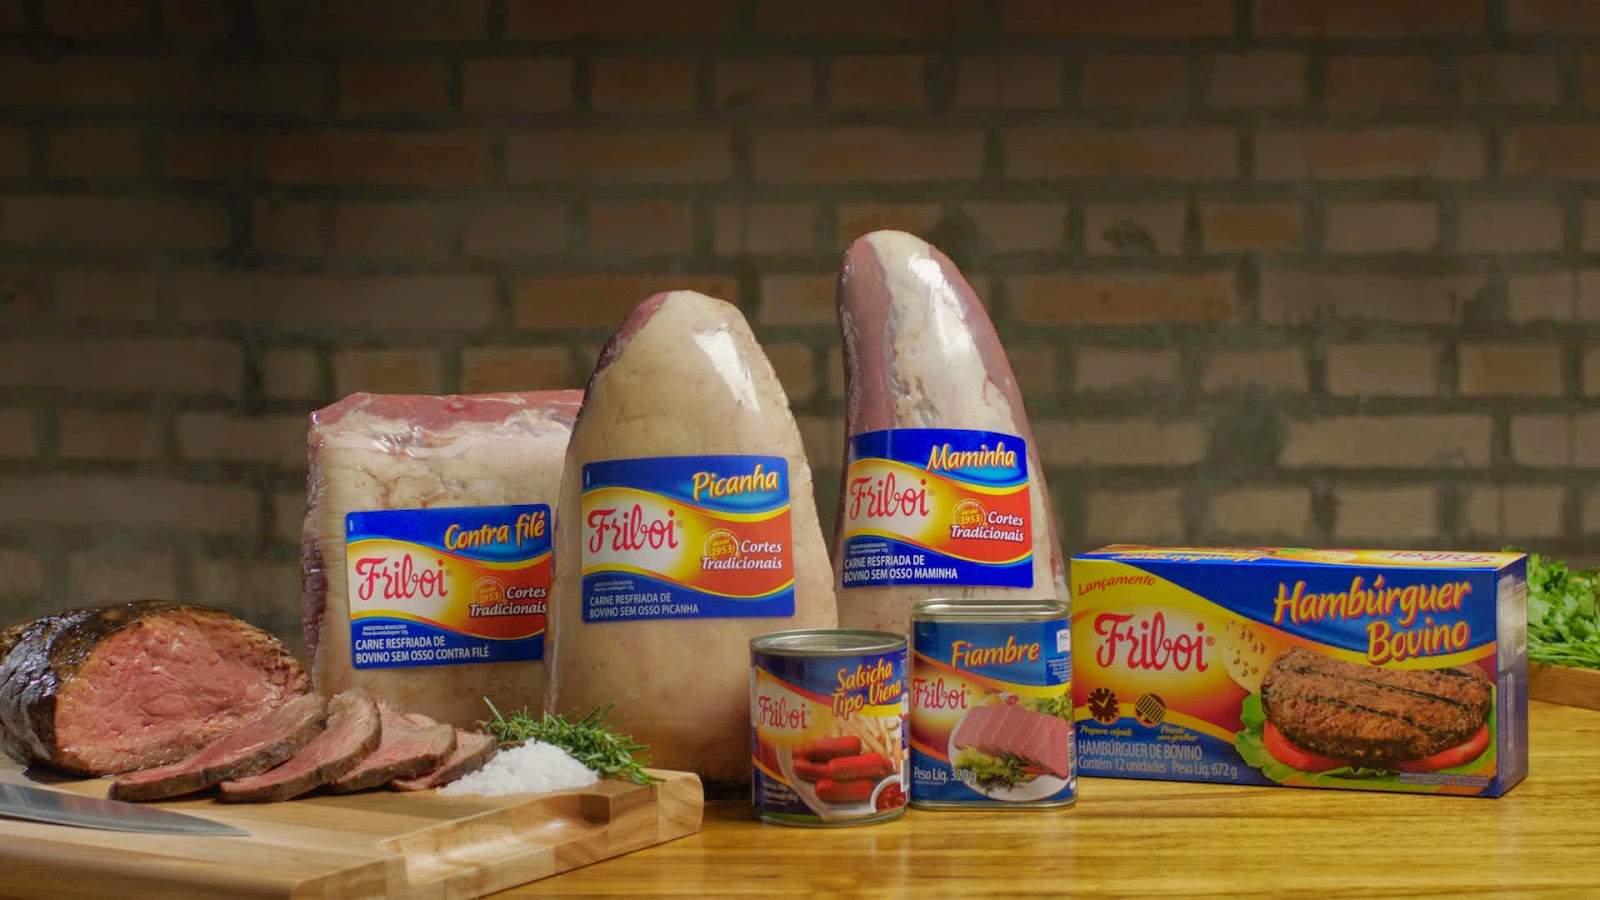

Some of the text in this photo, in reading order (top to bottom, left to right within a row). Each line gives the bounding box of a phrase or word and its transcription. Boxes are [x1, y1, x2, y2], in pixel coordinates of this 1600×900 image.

[926, 442, 1016, 472] Maminha
[692, 464, 779, 500] Picanha
[850, 472, 929, 520] Friboi
[961, 514, 981, 525] 1953
[988, 511, 1023, 526] Cortes
[444, 511, 547, 550] Contra filé
[951, 525, 1024, 542] Tradicionais
[712, 545, 733, 556] 1953
[741, 540, 782, 553] Cortes
[702, 557, 782, 570] Tradicionais
[845, 555, 925, 569] CARNE RESFRIADA DE
[355, 553, 448, 600] Friboi
[844, 567, 958, 582] BOVINO SEM OSSO MAMINHA
[506, 586, 547, 599] Cortes
[1078, 575, 1156, 596] Lançamento
[480, 592, 500, 603] 1953
[590, 593, 671, 607] CARNE RESFRIADA DE
[1273, 574, 1472, 626] Hambúrguer
[470, 601, 547, 616] Tradicionais
[589, 603, 699, 618] BOVINO SEM OSSO PICANHA
[355, 636, 445, 650] CARNE RESFRIADA DE
[1367, 618, 1471, 665] Bovino
[355, 644, 490, 664] BOVINO SEM OSSO CONTRA FILÉ
[951, 635, 1041, 669] Fiambre
[835, 658, 893, 692] Salsicha
[831, 679, 901, 720] Tipo Viena
[913, 678, 968, 709] Friboi
[758, 695, 809, 729] Friboi
[1079, 737, 1203, 760] HAMBÚRGUER DE BOVINO
[914, 766, 931, 780] Peso
[1079, 756, 1112, 770] Contém
[1115, 759, 1125, 771] 12
[1127, 758, 1167, 773] unidades
[1173, 760, 1193, 774] Peso
